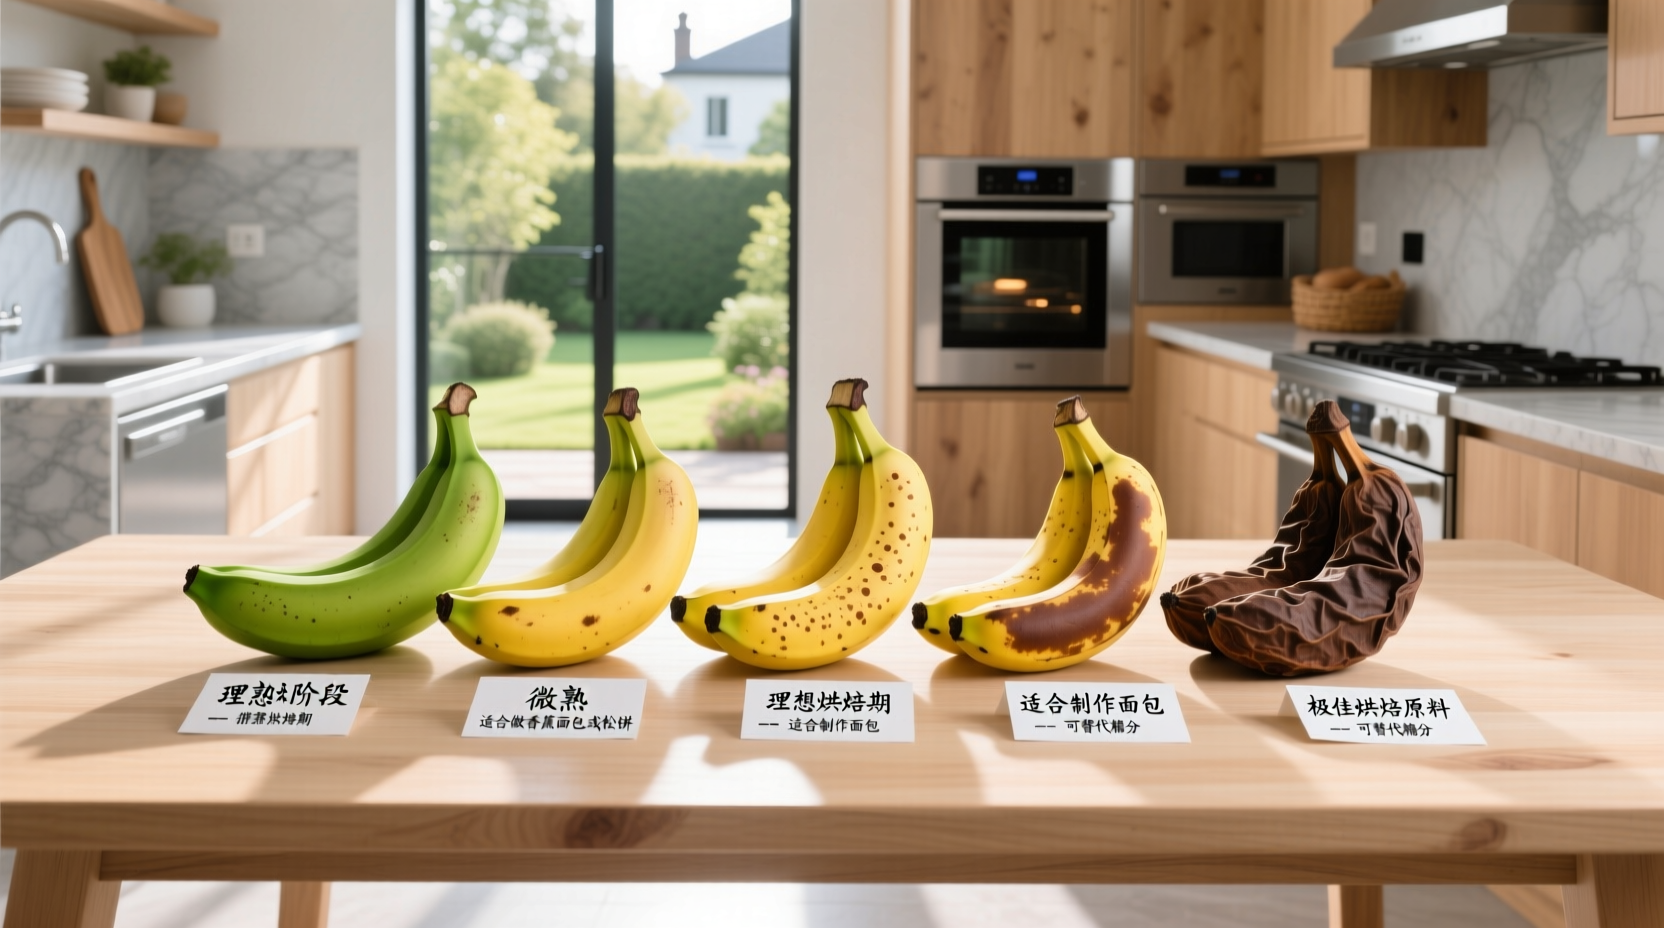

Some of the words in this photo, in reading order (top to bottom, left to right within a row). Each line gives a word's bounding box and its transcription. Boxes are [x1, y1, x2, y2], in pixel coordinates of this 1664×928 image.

[525, 684, 589, 712] 微熟
[765, 690, 891, 715] 理想烘焙期
[1019, 692, 1165, 715] 适合制作面包
[1307, 694, 1451, 719] 极佳烘焙原料
